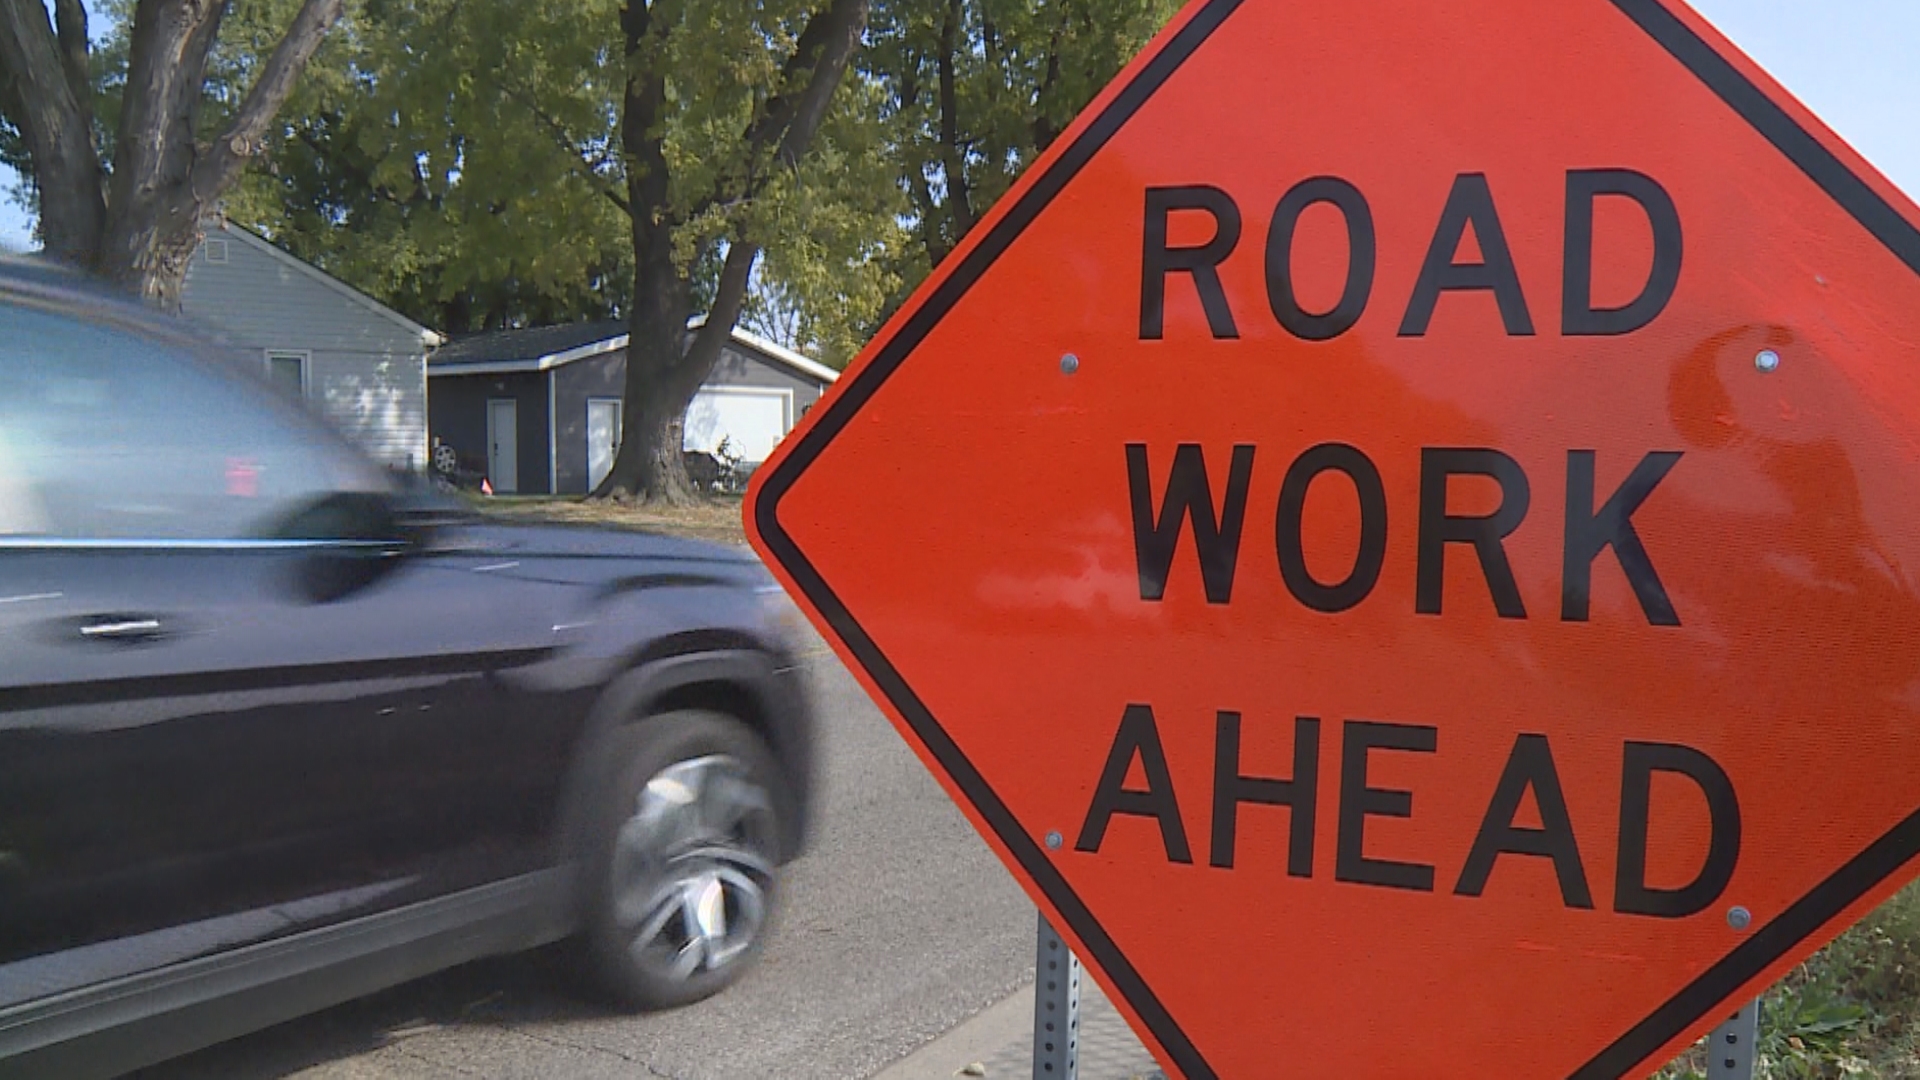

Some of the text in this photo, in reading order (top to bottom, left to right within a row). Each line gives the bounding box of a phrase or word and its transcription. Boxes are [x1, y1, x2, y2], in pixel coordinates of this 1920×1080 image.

[1139, 168, 1684, 341] ROAD
[1125, 442, 1686, 627] WORK
[1074, 703, 1742, 919] AHEAD
